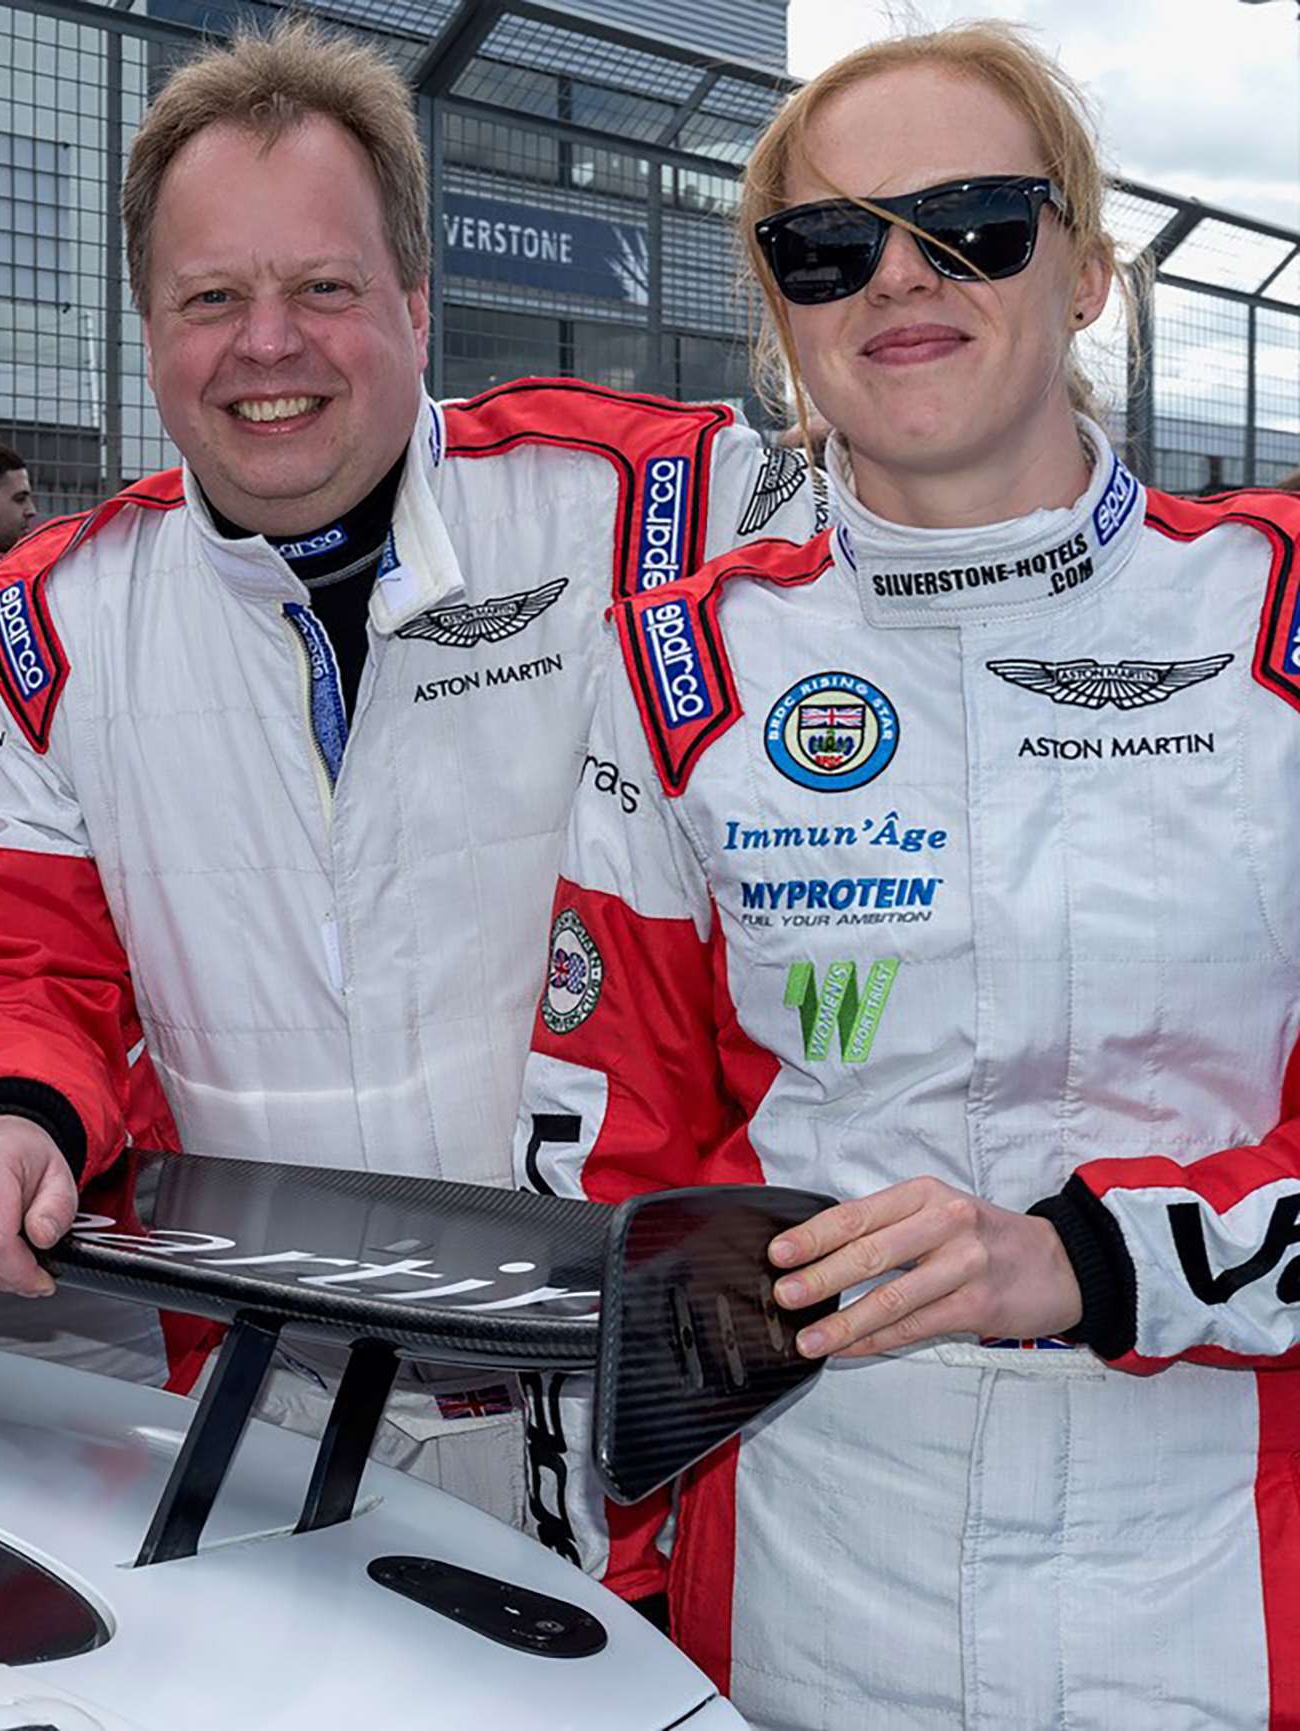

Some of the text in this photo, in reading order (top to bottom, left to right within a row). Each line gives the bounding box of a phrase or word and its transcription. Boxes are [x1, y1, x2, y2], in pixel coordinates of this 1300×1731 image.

[442, 213, 572, 263] VERSTONE
[872, 533, 1088, 597] SILVERSTONE-HOTELS
[1047, 558, 1094, 597] .COM
[414, 654, 563, 703] ASTON MARTIN
[768, 676, 894, 741] BRDC RISING STAR
[1018, 733, 1215, 760] ASTON MARTIN
[741, 878, 937, 911] MYPROTEIN
[781, 914, 830, 927] YOUR
[836, 910, 932, 926] AMBITION
